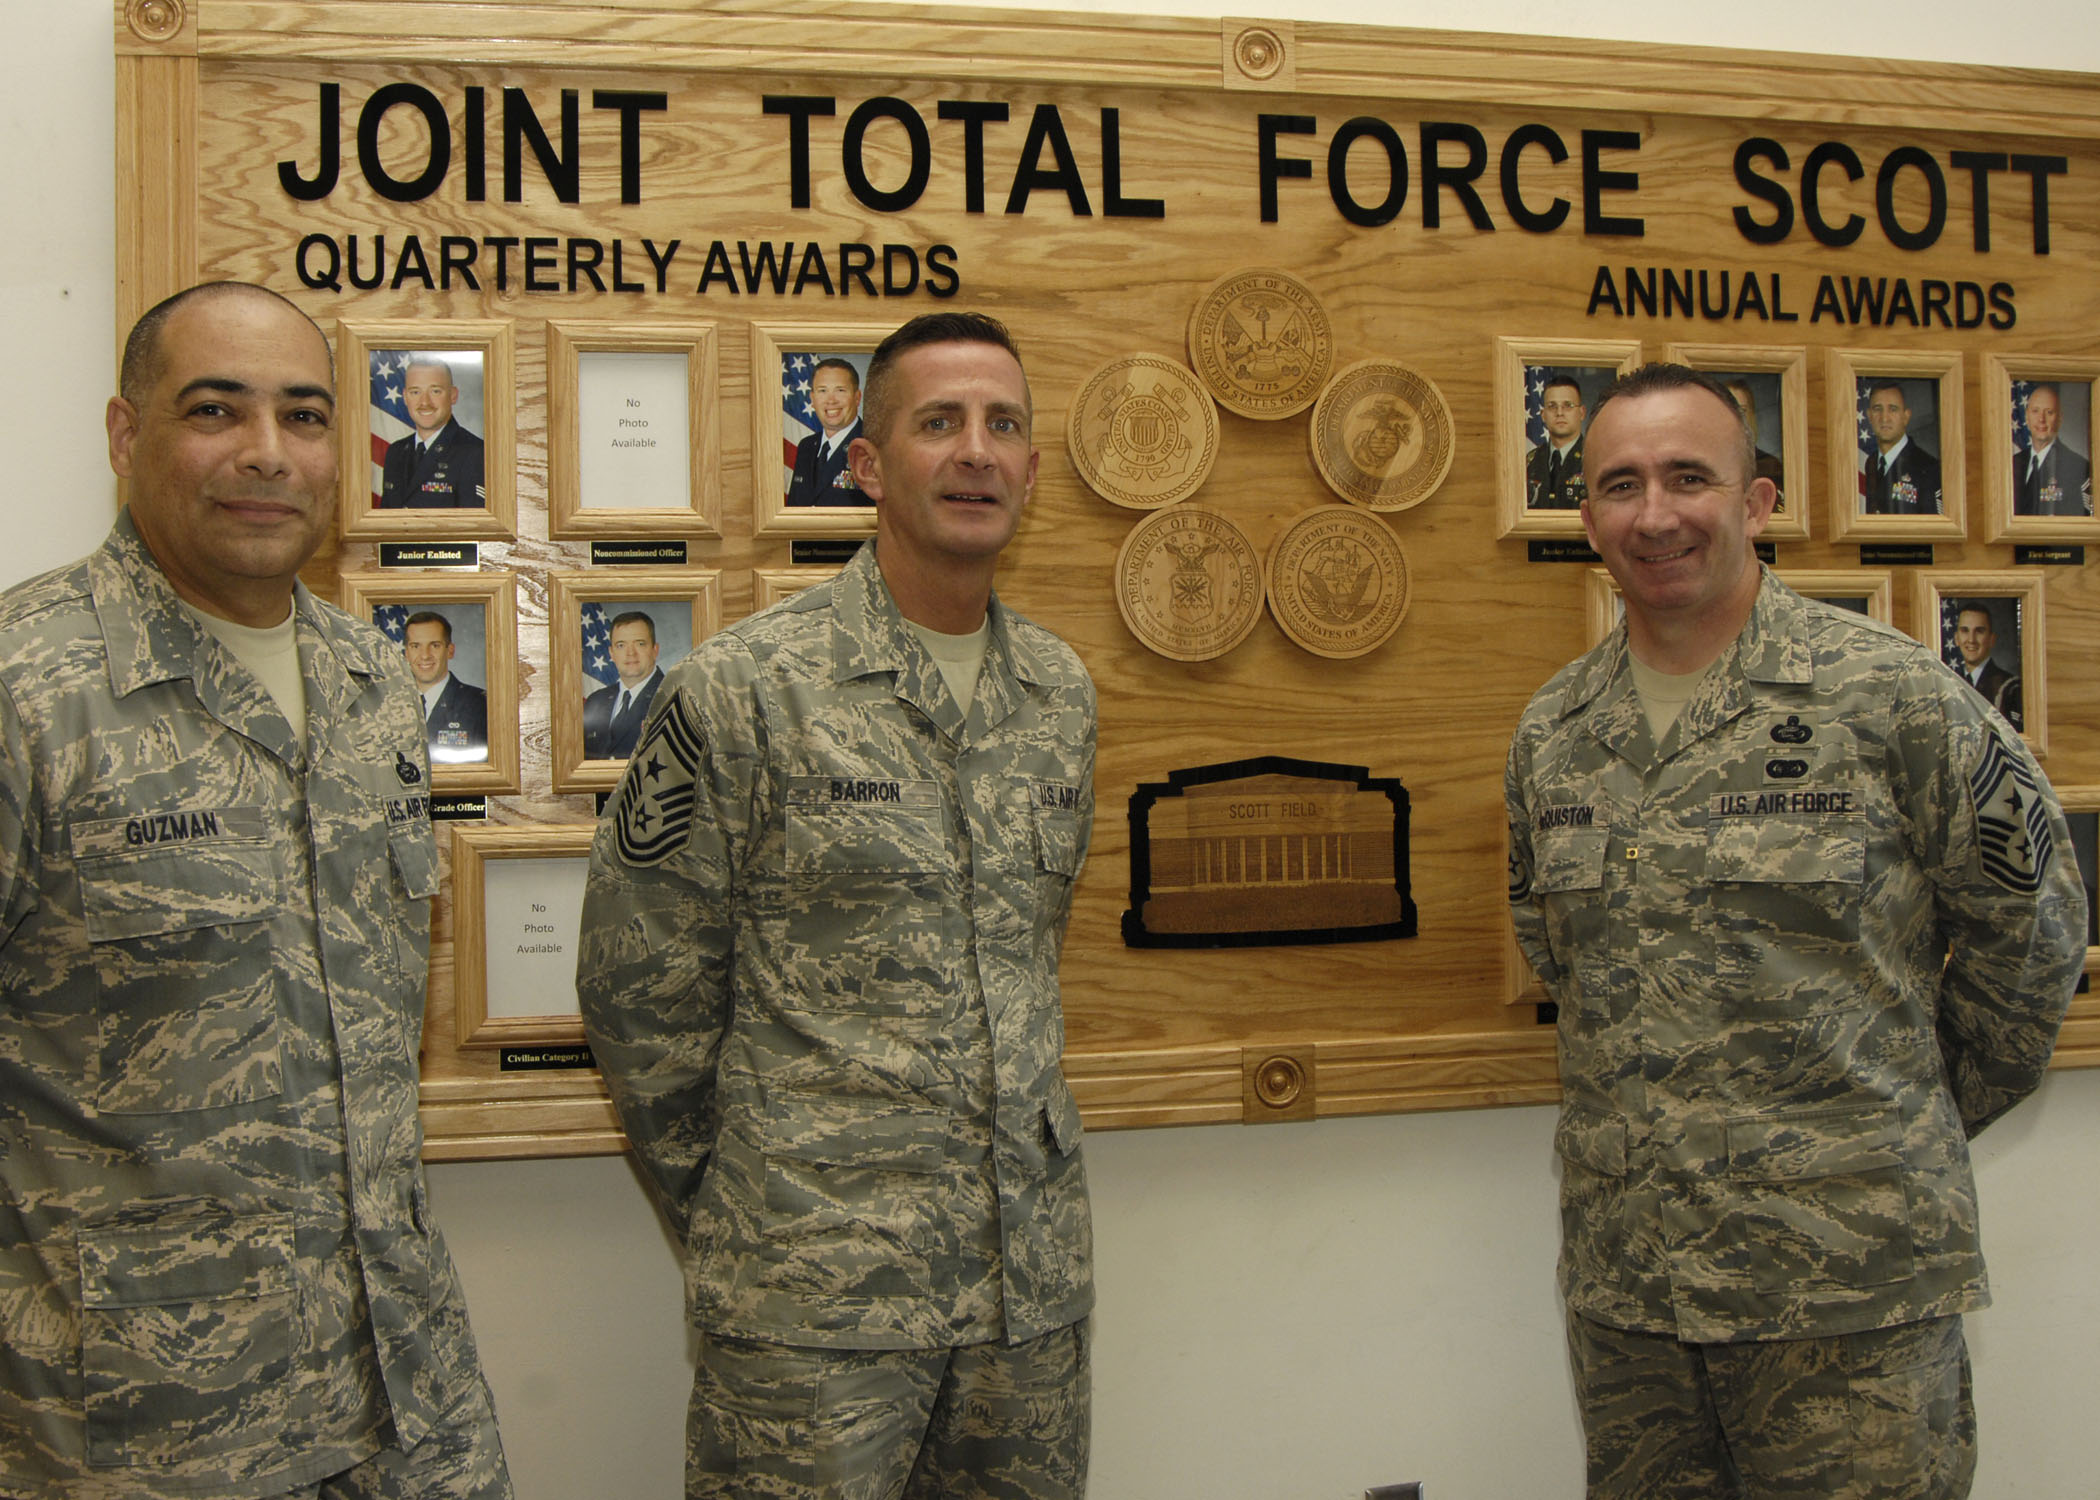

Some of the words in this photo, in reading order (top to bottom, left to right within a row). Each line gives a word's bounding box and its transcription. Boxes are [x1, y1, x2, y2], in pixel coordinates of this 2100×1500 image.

[277, 82, 668, 206] JOINT
[762, 94, 1165, 219] TOTAL
[1257, 113, 1645, 238] FORCE
[1732, 136, 2068, 256] SCOTT
[295, 233, 681, 294] QUARTERLY
[696, 240, 960, 302] AWARDS
[1203, 279, 1259, 336] DEPARTMENT
[1265, 279, 1280, 289] OF
[1285, 285, 1305, 305] THE
[1307, 306, 1325, 338] ARMY
[1586, 265, 1799, 322] ANNUAL
[1809, 275, 2017, 330] AWARDS
[1203, 347, 1230, 390] UNITED
[1231, 388, 1277, 408] STATES
[1280, 393, 1295, 406] OF
[1295, 347, 1326, 396] AMERICA
[1254, 382, 1280, 391] 1775
[626, 398, 641, 408] No
[1118, 399, 1146, 420] STATES
[1148, 400, 1172, 422] COAST
[618, 418, 649, 428] Photo
[611, 438, 657, 448] Available
[1113, 420, 1129, 454] UNITED
[1136, 454, 1156, 463] 1790
[397, 551, 425, 560] Junior
[427, 550, 462, 560] Enlisted
[594, 549, 657, 558] Noncommissioned
[658, 548, 684, 557] Officer
[1286, 524, 1340, 572] DEPARTMENT
[1344, 524, 1359, 534] OF
[1362, 531, 1381, 549] THE
[1378, 548, 1395, 575] NAVY
[1127, 525, 1164, 605] DEPARTMENT
[1170, 517, 1189, 529] OF
[1197, 518, 1224, 535] THE
[1226, 536, 1245, 558] AIR
[1240, 564, 1254, 608] FORCE
[1284, 584, 1307, 623] UNITED
[1306, 621, 1342, 638] STATES
[1345, 628, 1359, 638] OF
[1362, 593, 1393, 631] AMERICA
[830, 780, 901, 802] BARRON
[1039, 784, 1058, 809] U.S.
[386, 799, 407, 822] U.S.
[406, 797, 423, 820] AIR
[430, 803, 455, 812] Grade
[456, 802, 486, 812] Officer
[1229, 803, 1269, 819] SCOTT
[1282, 802, 1317, 818] FIELD
[1720, 794, 1750, 816] U.S.
[1754, 793, 1787, 815] AIR
[1790, 791, 1854, 814] FORCE
[125, 811, 220, 846] GUZMAN
[531, 903, 546, 913] No
[524, 923, 554, 934] Photo
[516, 943, 562, 954] Available
[507, 1054, 540, 1063] Civilian
[542, 1052, 579, 1063] Category
